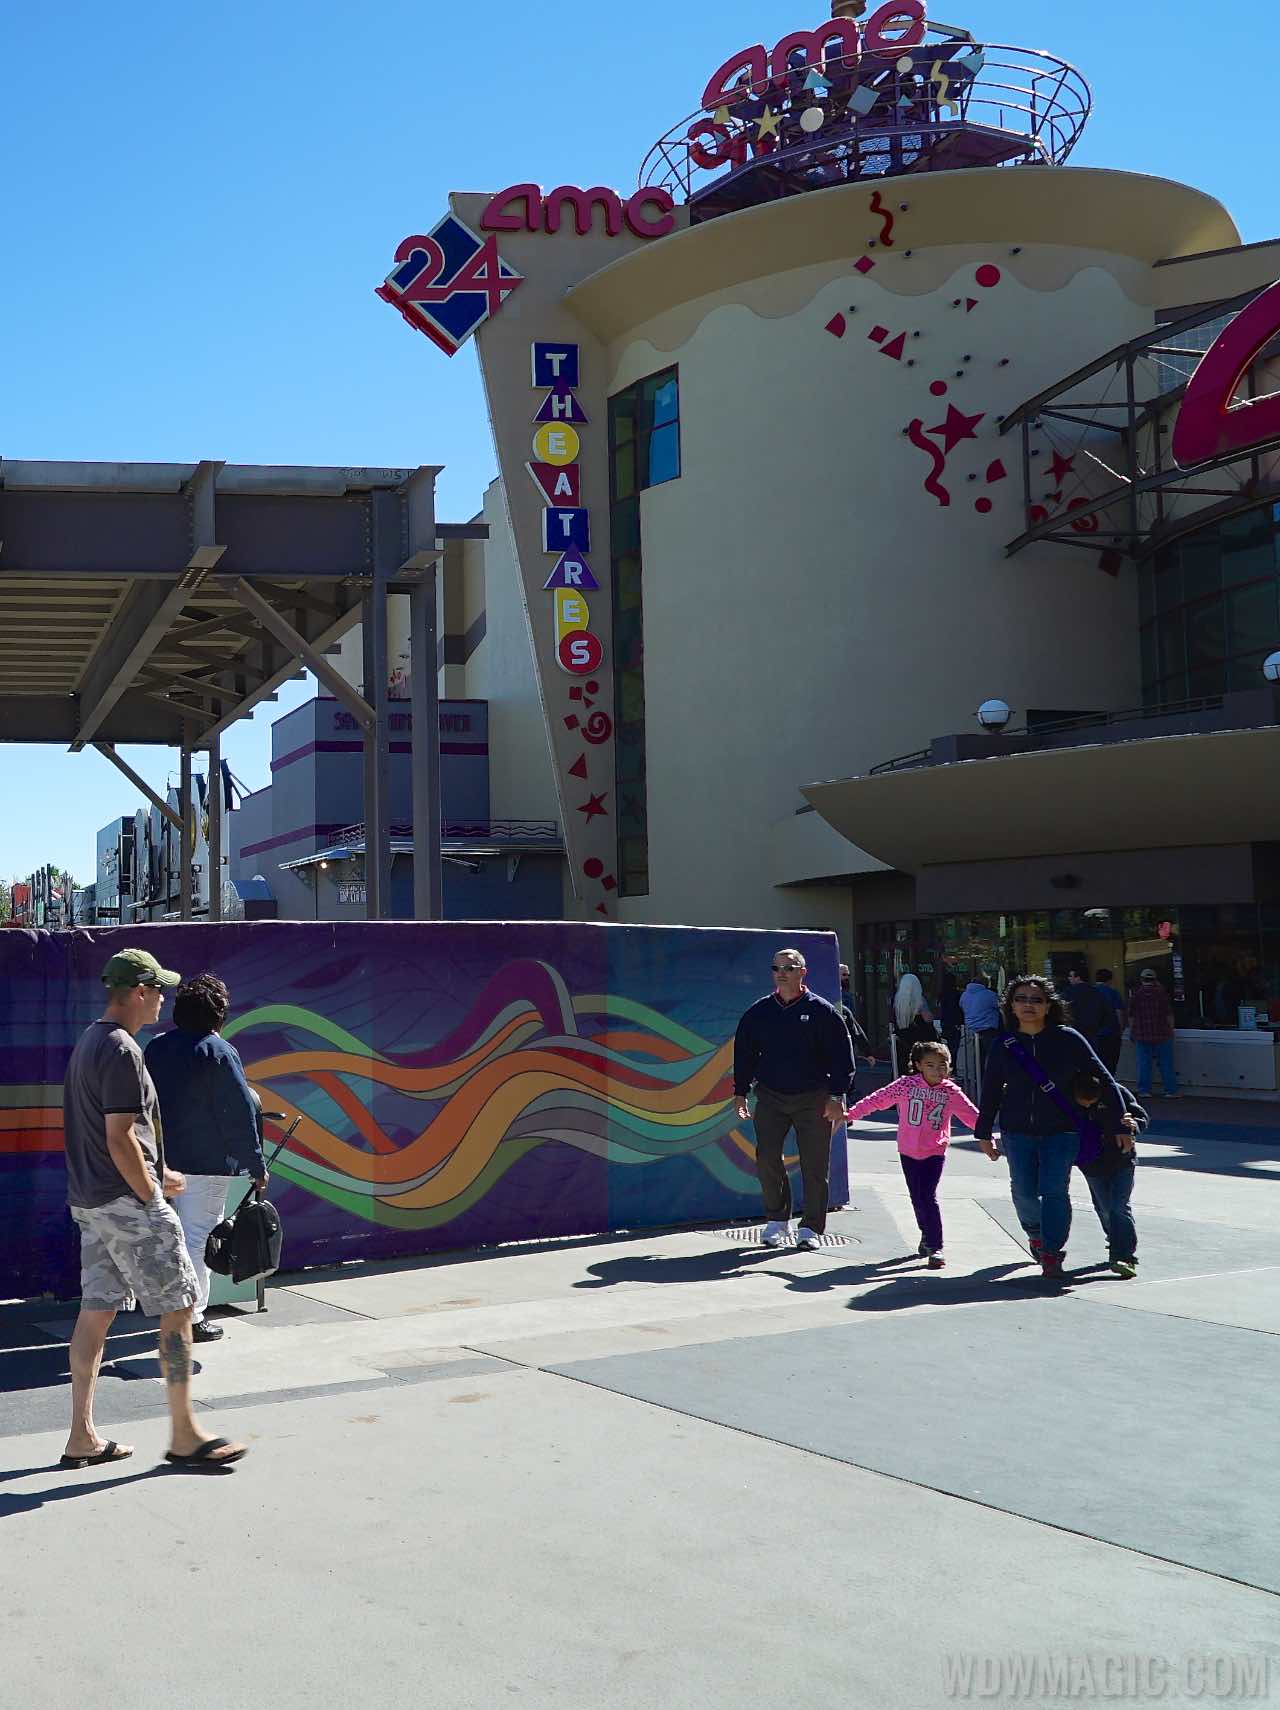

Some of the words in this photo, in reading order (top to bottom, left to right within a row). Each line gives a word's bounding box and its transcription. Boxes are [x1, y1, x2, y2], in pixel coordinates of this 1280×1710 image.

[701, 0, 926, 107] amc
[480, 183, 675, 238] amc
[377, 233, 524, 318] 24
[544, 352, 591, 667] THEATRES
[907, 1098, 945, 1131] 04
[909, 1087, 950, 1104] JUSTICE
